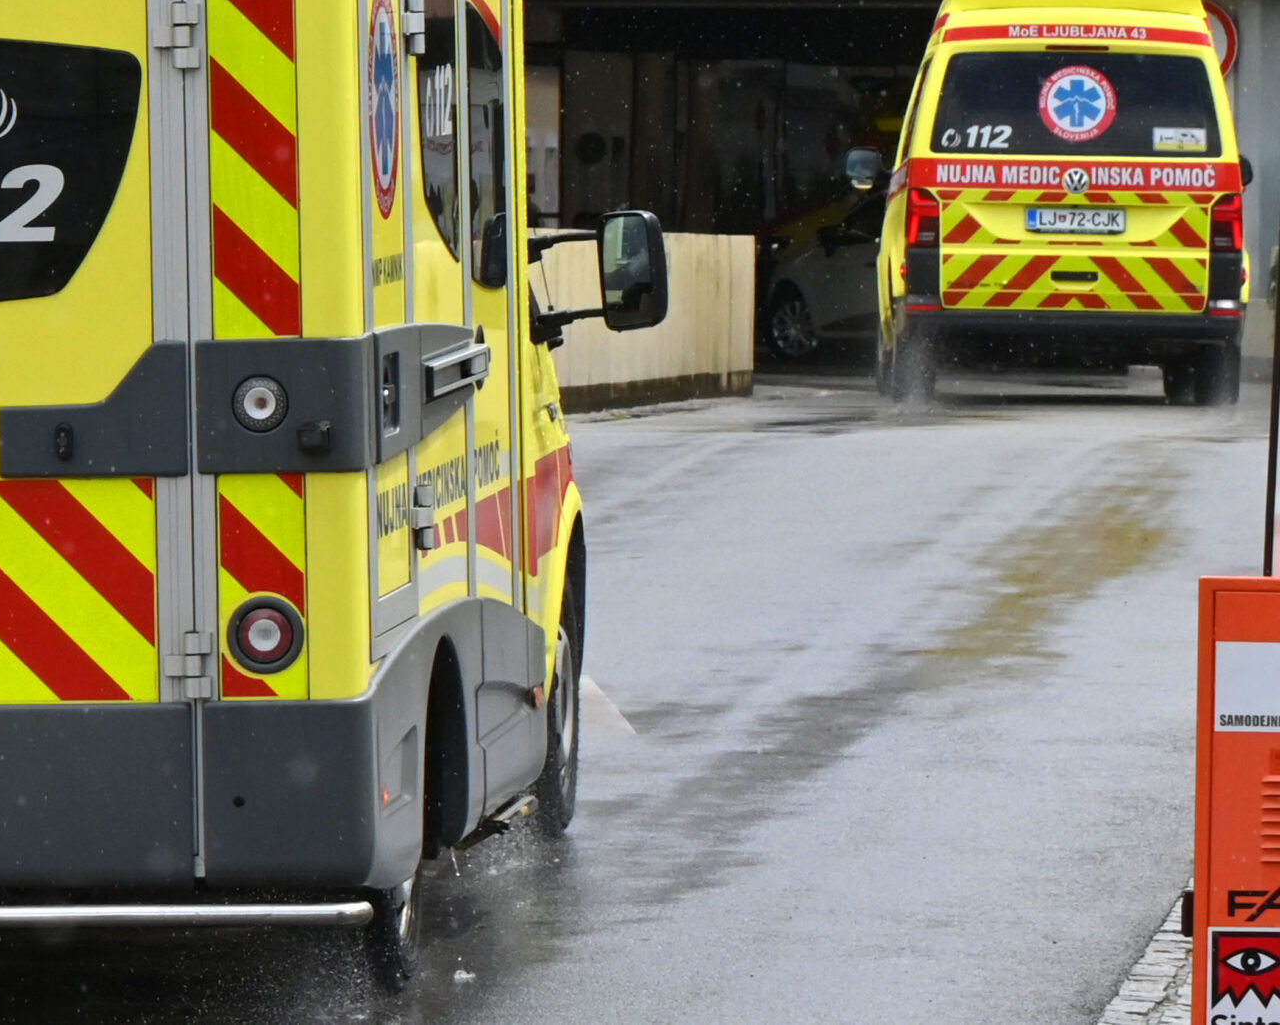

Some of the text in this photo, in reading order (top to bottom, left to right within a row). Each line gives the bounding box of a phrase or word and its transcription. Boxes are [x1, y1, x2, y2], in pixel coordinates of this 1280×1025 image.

[1008, 25, 1147, 40] MoE LJUBLJANA 43
[1051, 67, 1101, 82] MEDICINSKA
[435, 63, 452, 137] 112
[966, 125, 1013, 148] 112
[1053, 127, 1099, 141] SLOVENIJA
[936, 163, 1216, 187] NUJNA MEDIC INSKA POMOČ
[1039, 211, 1120, 227] LJ 72-CJK
[376, 482, 409, 540] NUJNA
[1219, 714, 1280, 727] SAMODEJN
